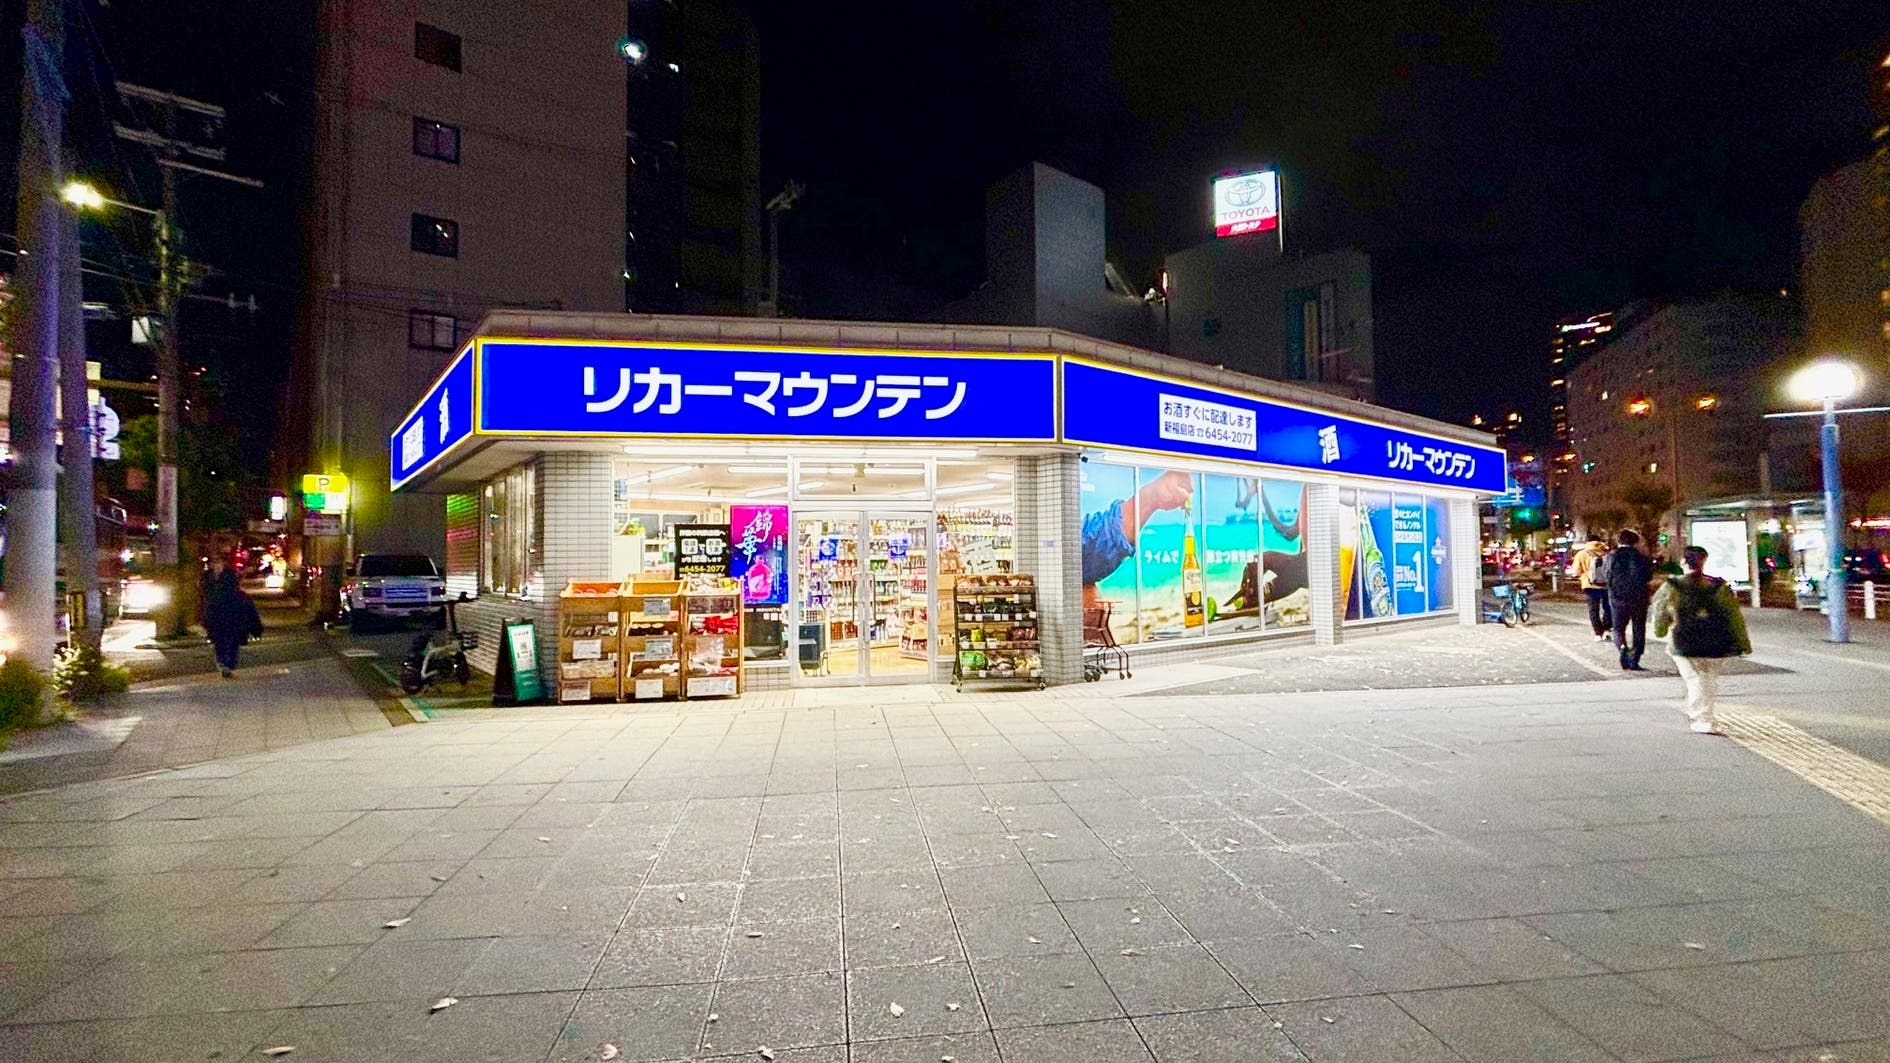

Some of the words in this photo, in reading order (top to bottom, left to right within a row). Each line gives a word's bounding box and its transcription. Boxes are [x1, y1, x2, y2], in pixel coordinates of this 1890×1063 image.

[1221, 206, 1271, 221] TOYOTA
[583, 366, 967, 420] リカーマウンテン
[1163, 401, 1253, 430] お酒すぐに配達します
[1164, 420, 1196, 437] 新福島店
[1318, 424, 1341, 465] 酒
[1387, 439, 1476, 479] リカーマウンテン
[318, 477, 330, 492] P
[1144, 549, 1180, 564] ライムで
